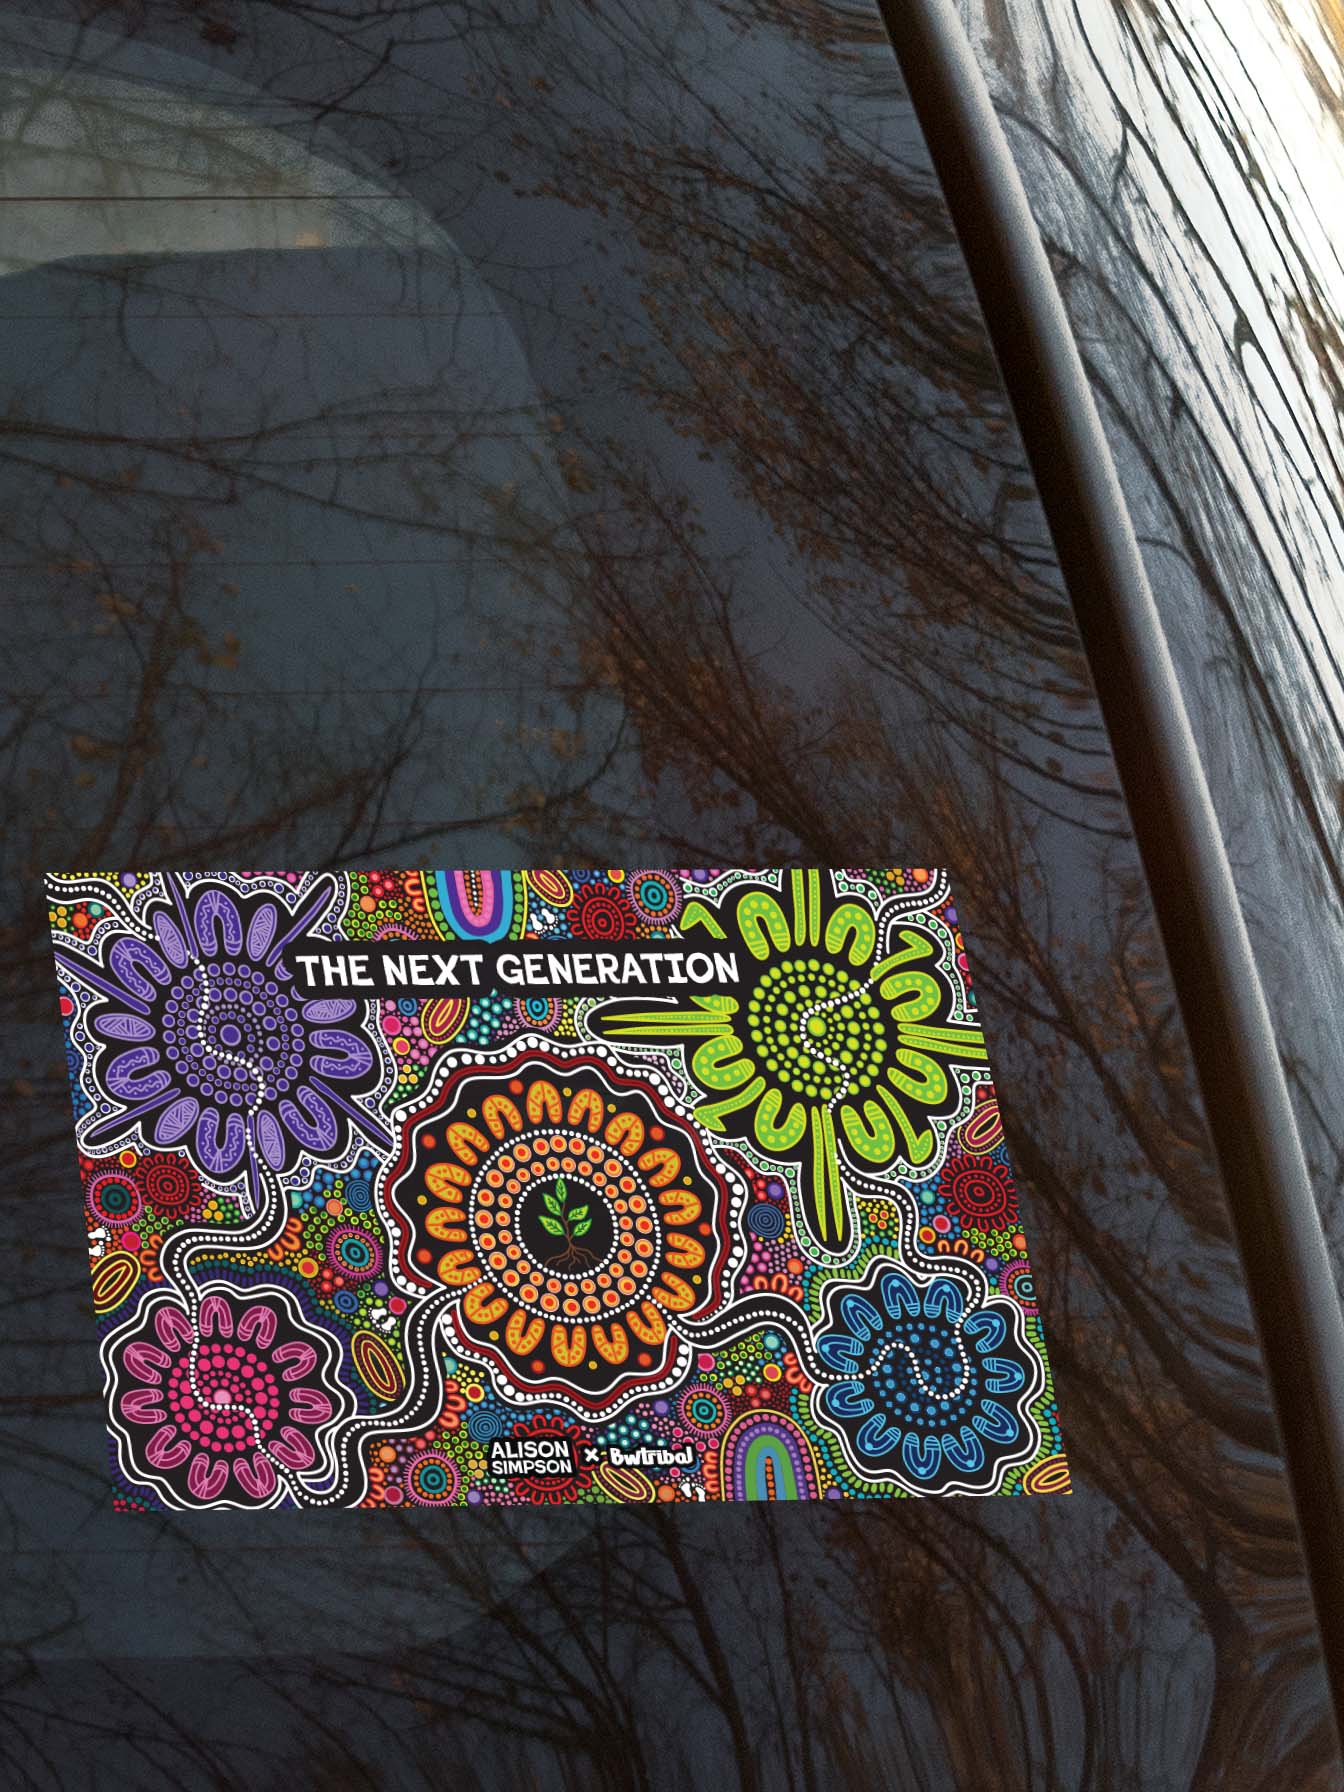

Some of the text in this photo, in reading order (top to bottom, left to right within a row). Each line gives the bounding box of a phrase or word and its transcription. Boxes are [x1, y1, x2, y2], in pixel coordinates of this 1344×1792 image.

[295, 952, 740, 987] THE NEXT GENERATION
[491, 1440, 570, 1459] ALISON
[491, 1459, 573, 1475] SIMPSON
